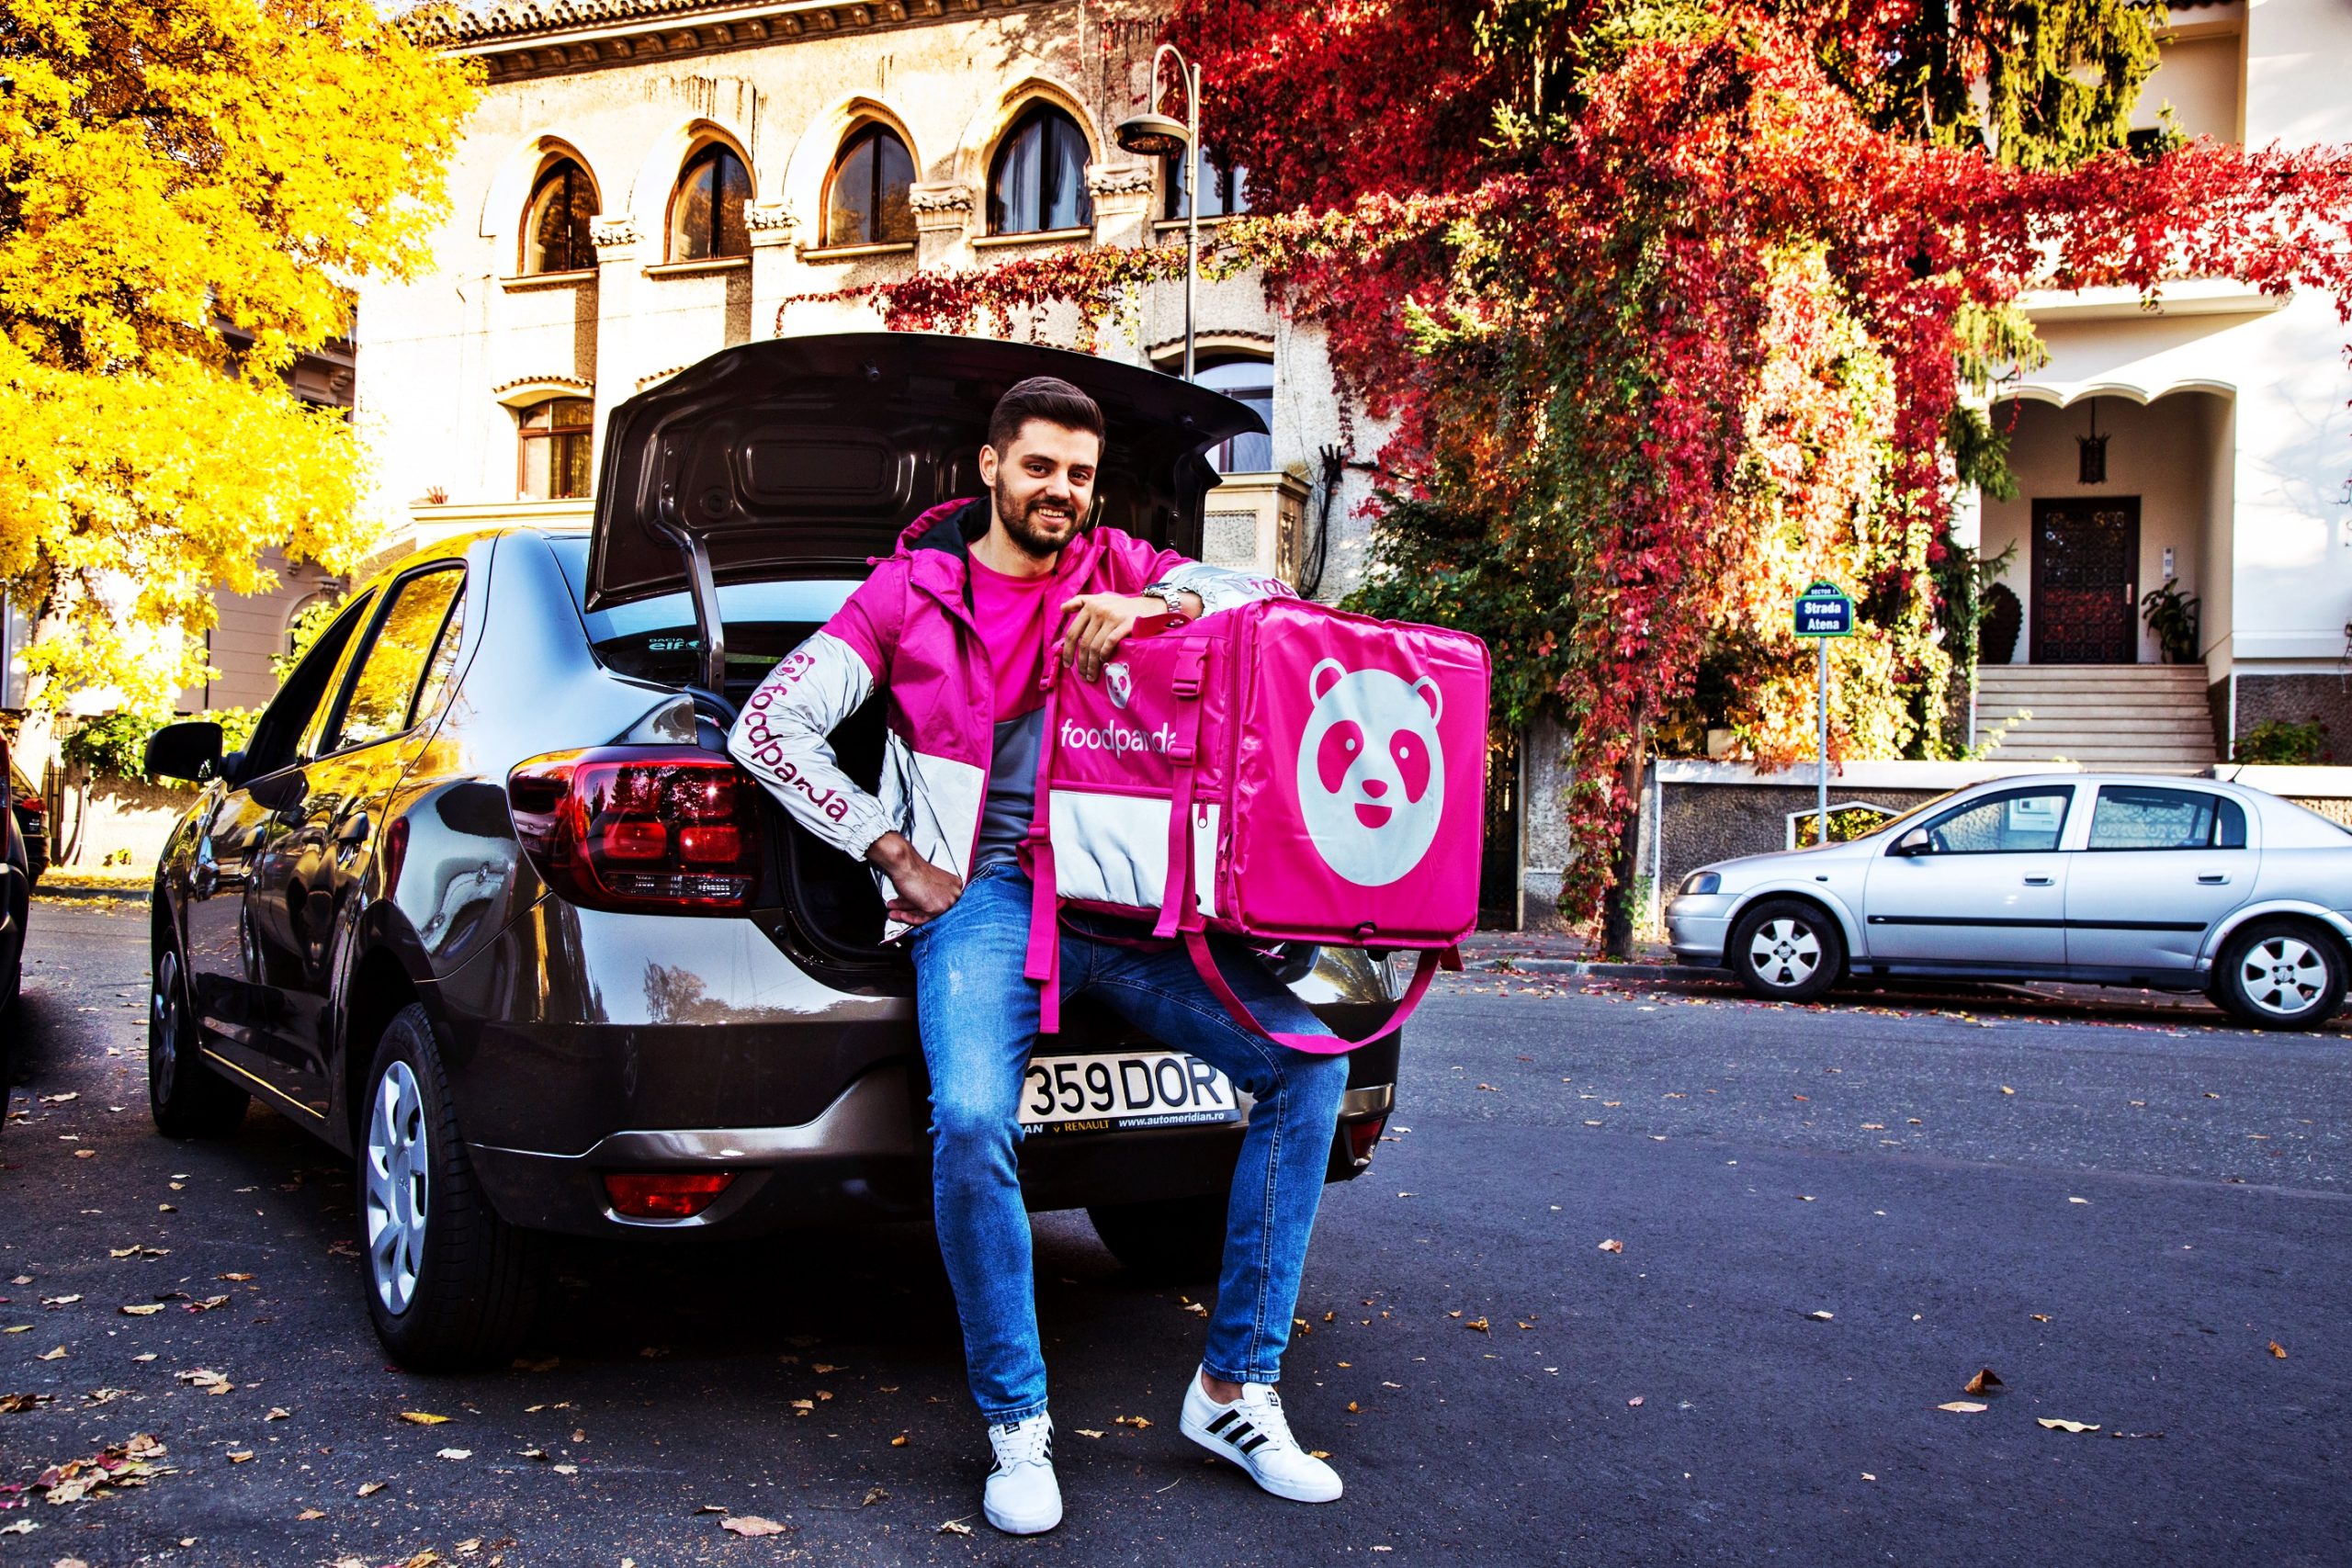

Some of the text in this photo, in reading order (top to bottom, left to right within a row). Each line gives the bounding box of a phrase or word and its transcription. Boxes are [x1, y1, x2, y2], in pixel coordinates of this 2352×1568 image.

[1804, 602, 1841, 615] Strada
[1807, 618, 1840, 630] Atena
[649, 642, 684, 650] elf
[1024, 1056, 1224, 1116] 359 DOR
[1064, 1120, 1110, 1132] RENAULT
[1118, 1112, 1225, 1128] www.automeridian.ro
